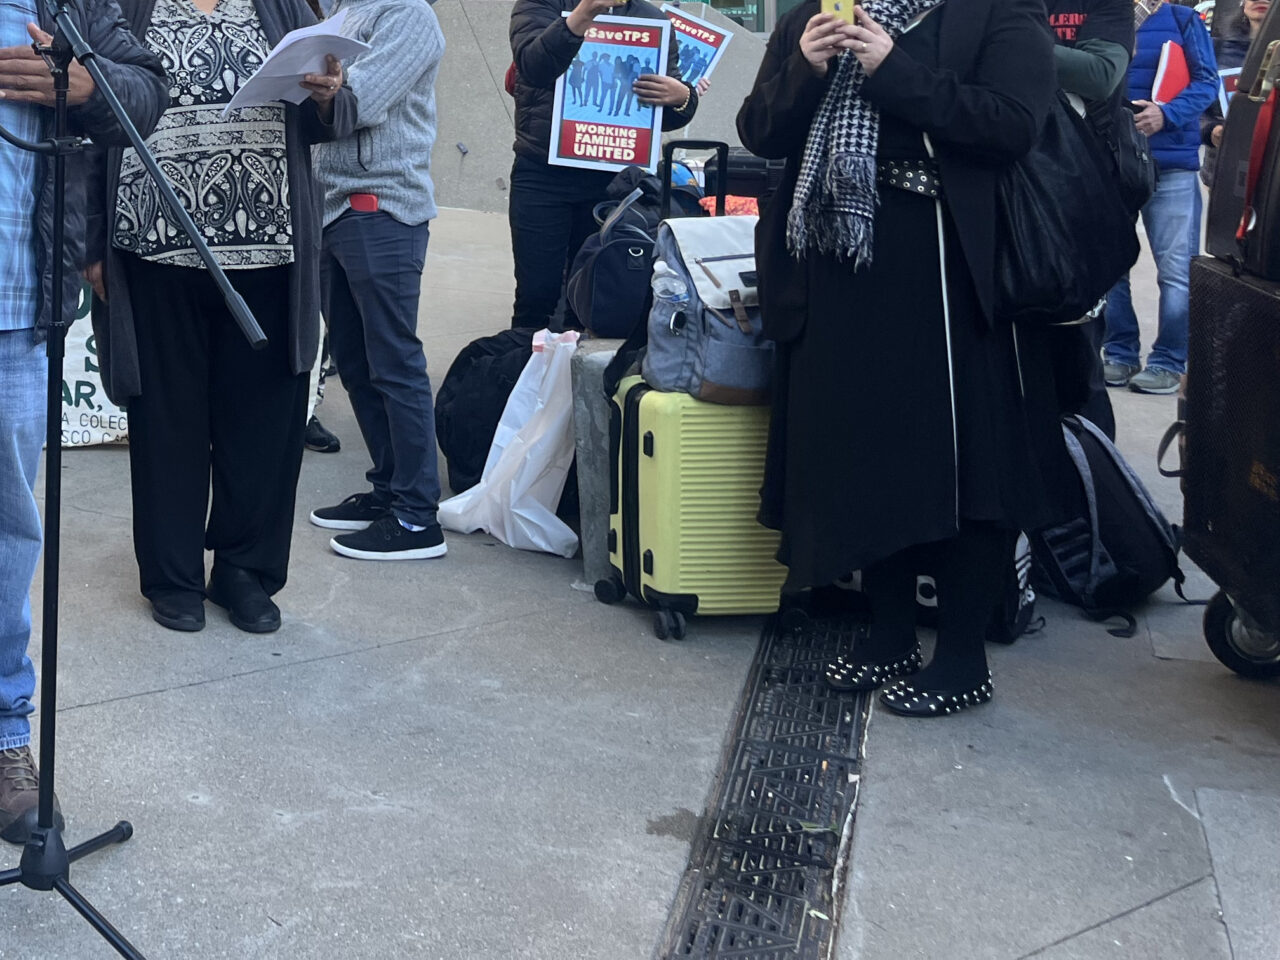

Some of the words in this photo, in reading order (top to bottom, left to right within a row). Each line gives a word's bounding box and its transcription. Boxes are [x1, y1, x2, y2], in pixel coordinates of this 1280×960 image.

[575, 123, 637, 138] WORKING
[575, 133, 636, 148] FAMILIES
[573, 144, 635, 161] UNITED
[80, 413, 127, 431] COLEC
[62, 429, 91, 444] SCO
